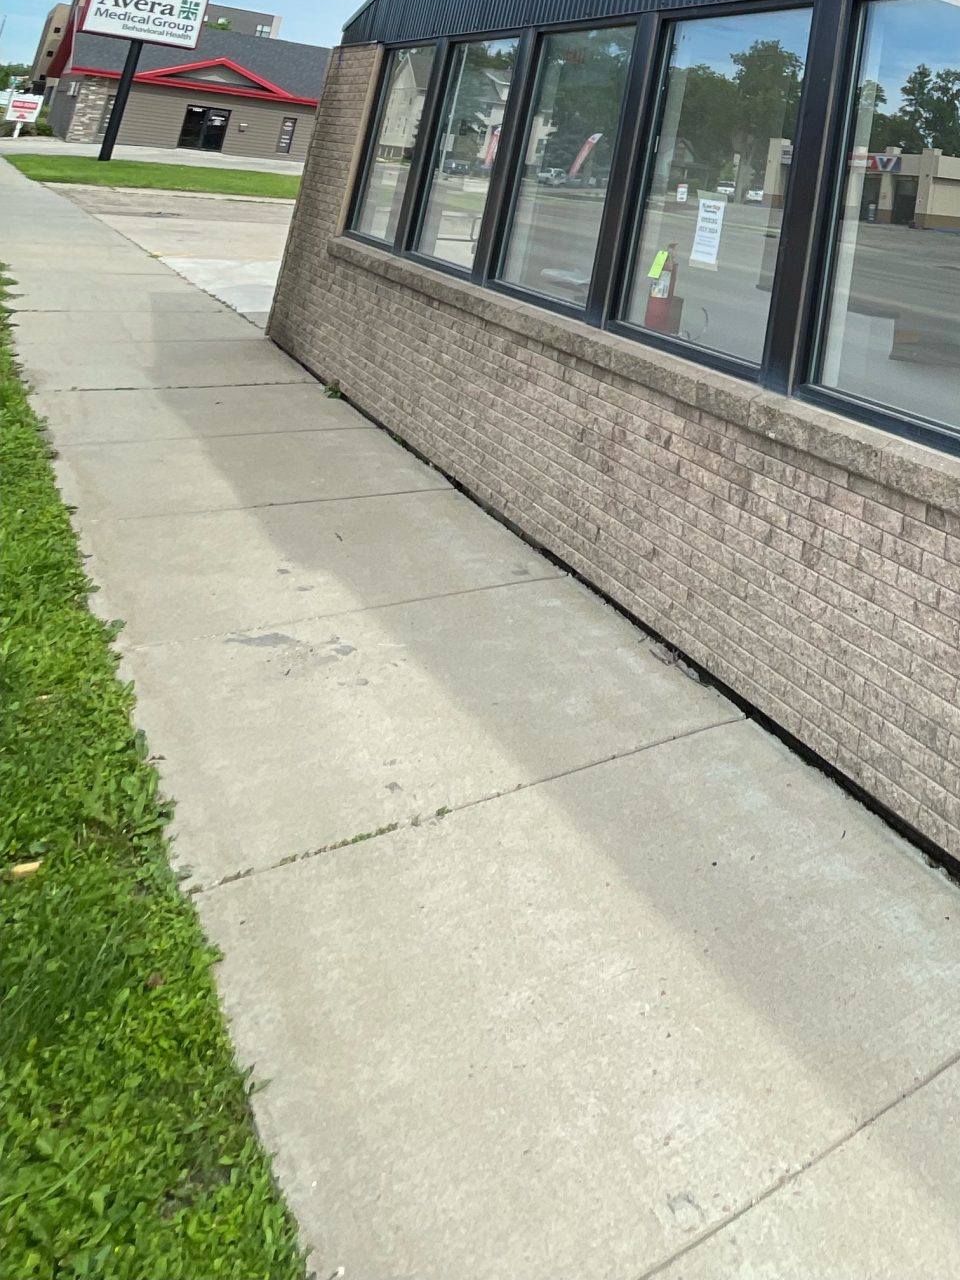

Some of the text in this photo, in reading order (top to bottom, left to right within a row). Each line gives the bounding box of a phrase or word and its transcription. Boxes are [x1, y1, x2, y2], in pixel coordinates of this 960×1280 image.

[94, 7, 194, 33] Medical Group
[121, 23, 192, 41] Behavioral Health
